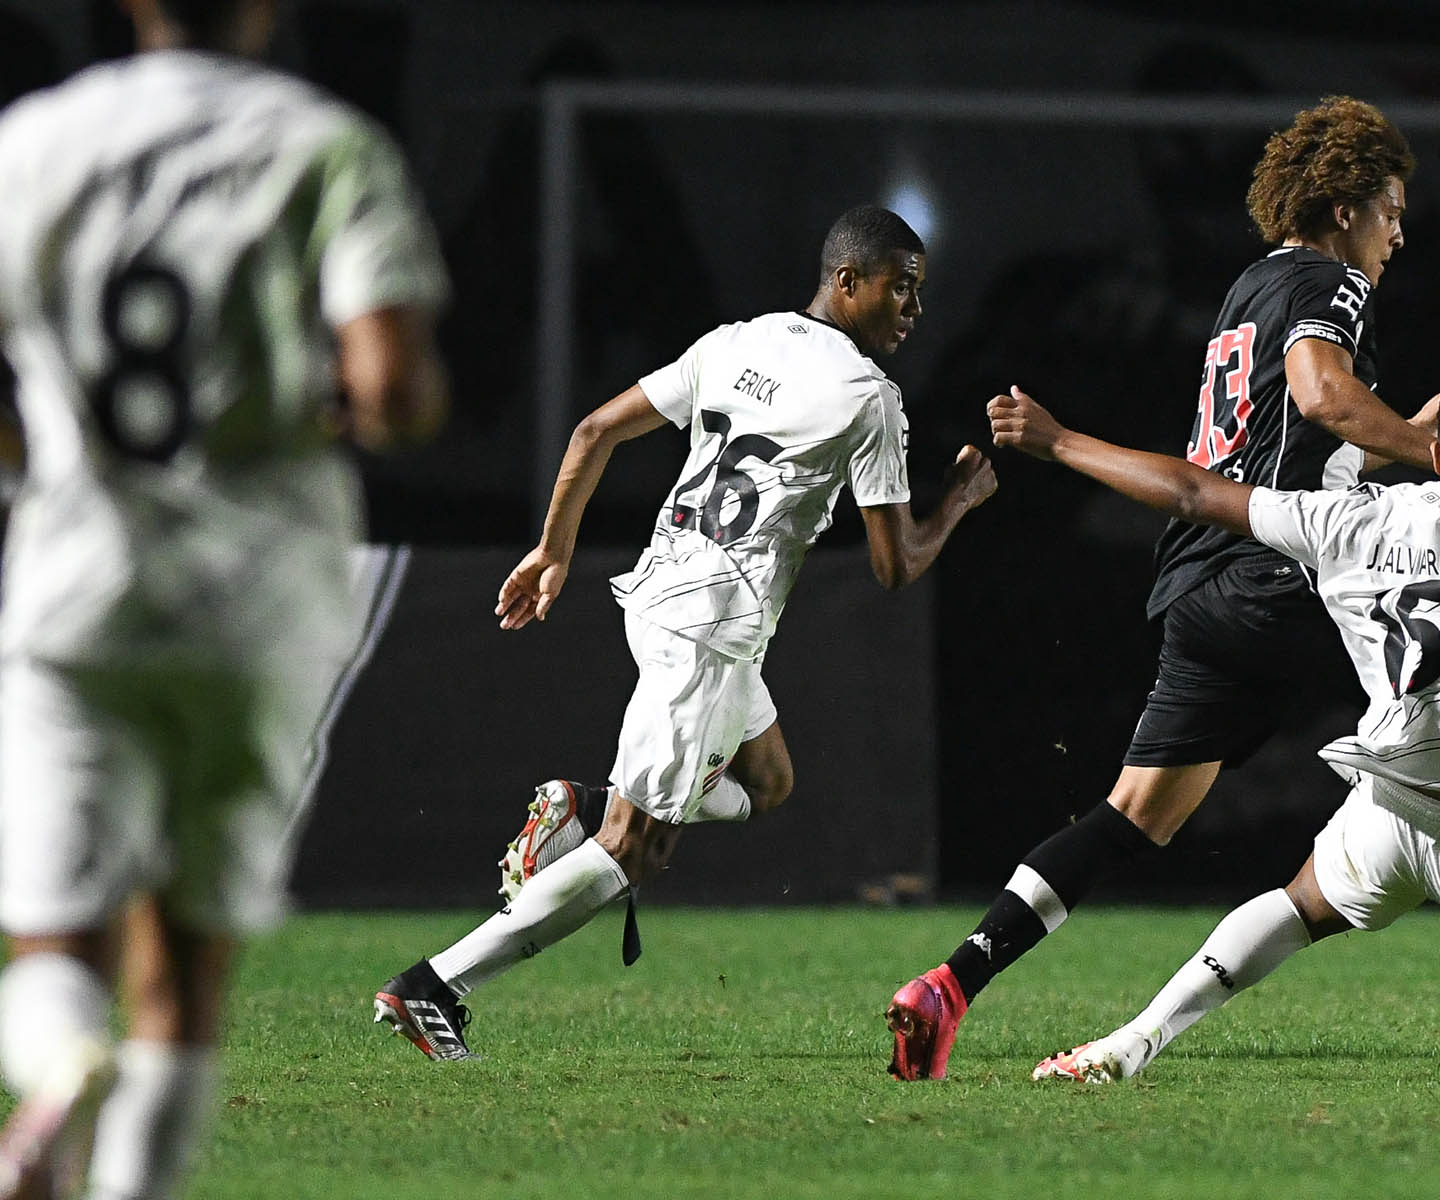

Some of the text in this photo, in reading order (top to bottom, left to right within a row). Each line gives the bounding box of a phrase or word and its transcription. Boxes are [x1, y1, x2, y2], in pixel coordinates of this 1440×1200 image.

[98, 262, 194, 464] 8
[733, 368, 781, 407] ERICK
[672, 408, 786, 546] 26
